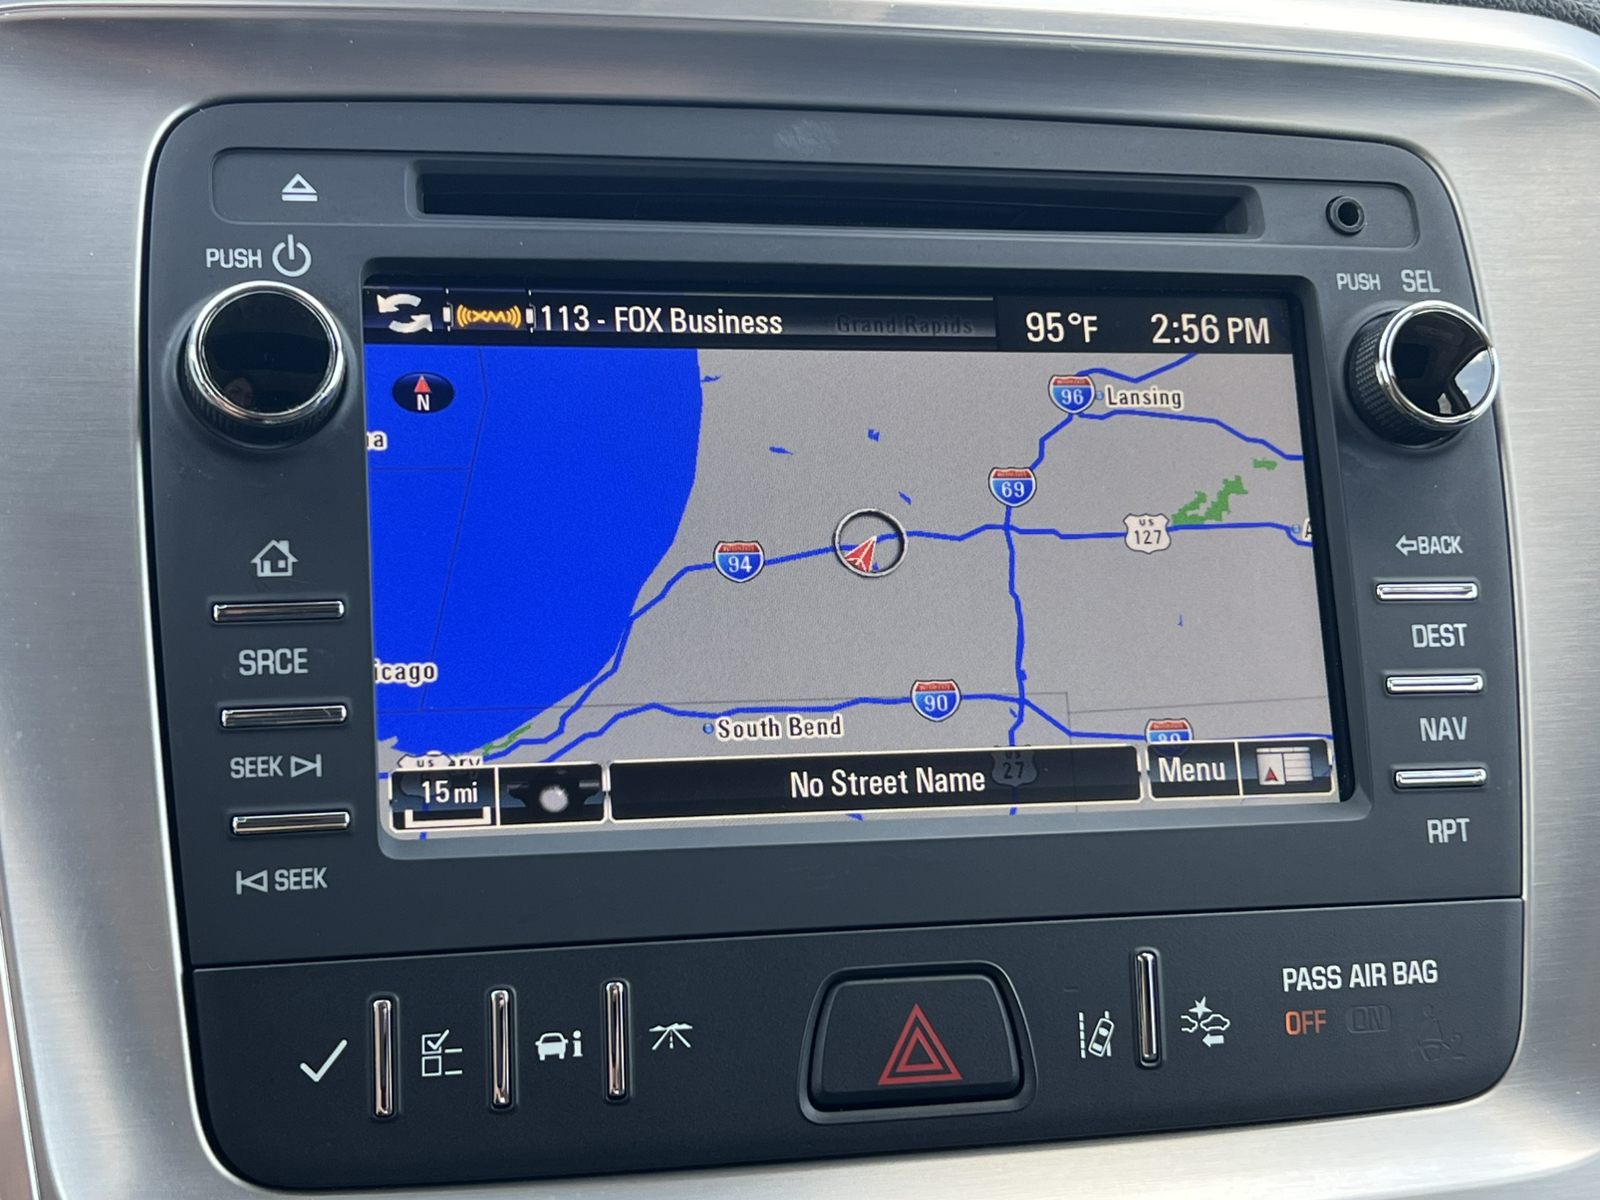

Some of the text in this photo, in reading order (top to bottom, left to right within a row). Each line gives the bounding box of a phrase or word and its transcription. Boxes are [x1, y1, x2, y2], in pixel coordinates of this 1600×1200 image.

[205, 247, 263, 269] PUSH
[1336, 272, 1381, 291] PUSH
[1401, 269, 1441, 293] SEL
[541, 305, 590, 332] 113
[614, 307, 663, 333] FOX
[671, 309, 783, 335] Business
[835, 313, 975, 337] Grand Rapids
[1025, 311, 1099, 344] 95°F
[1150, 313, 1271, 346] 2:56 PM
[416, 394, 430, 411] N
[1061, 388, 1084, 406] 96
[1106, 386, 1184, 409] Lansing
[1001, 480, 1025, 498] 69
[1138, 518, 1155, 527] US
[1134, 529, 1162, 546] 127
[1417, 535, 1463, 555] BACK
[727, 554, 753, 573] 94
[1411, 623, 1467, 648] DEST
[238, 648, 309, 676] SRCE
[924, 694, 949, 712] 90
[718, 715, 843, 738] South Bend
[1419, 716, 1467, 742] NAV
[230, 756, 284, 779] SEEK
[1002, 760, 1025, 780] 27
[1157, 756, 1226, 783] Menu
[421, 780, 478, 804] 15 mi
[790, 766, 986, 798] No Street Name
[1426, 818, 1470, 843] RPT
[273, 867, 328, 891] SEEK
[1283, 959, 1438, 992] PASS AIR BAG
[1284, 1008, 1327, 1036] OFF
